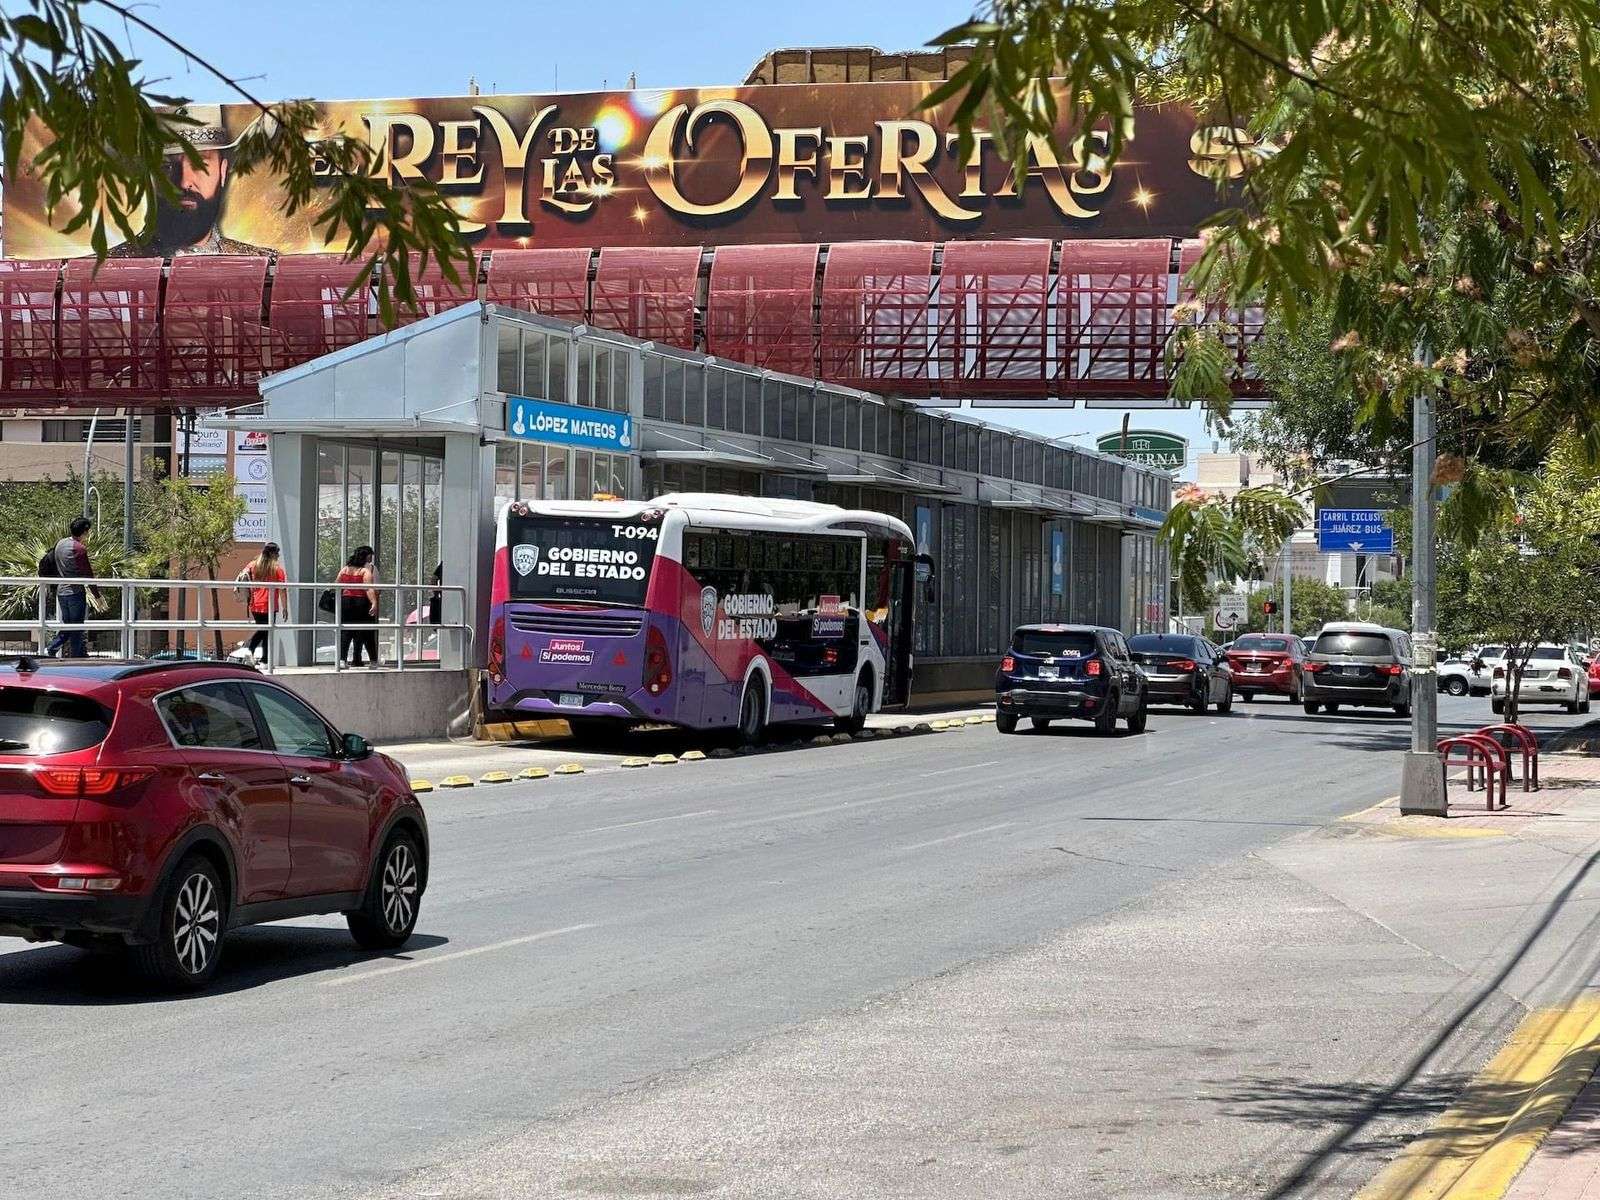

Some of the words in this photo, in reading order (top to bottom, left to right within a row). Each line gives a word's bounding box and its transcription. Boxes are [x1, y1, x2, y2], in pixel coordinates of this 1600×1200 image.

[547, 127, 596, 154] DE
[361, 104, 557, 233] REY
[643, 99, 1113, 220] OFERTAS
[539, 154, 615, 213] LAS
[529, 411, 568, 433] LÓPEZ
[571, 419, 617, 440] MATEOS
[1323, 512, 1348, 521] CARRIL
[1351, 512, 1384, 521] EXCLUSI
[611, 525, 659, 540] T-094
[1331, 522, 1361, 533] JUÁREZ
[1364, 525, 1382, 534] BUS
[547, 547, 638, 565] GOBIERNO
[537, 561, 571, 577] DEL
[574, 564, 646, 581] ESTADO
[723, 594, 774, 615] GOBIERNO
[718, 620, 737, 640] DEL
[740, 619, 778, 639] ESTADO
[819, 619, 844, 634] podemos
[551, 642, 581, 651] Juntos
[551, 652, 591, 662] podemos
